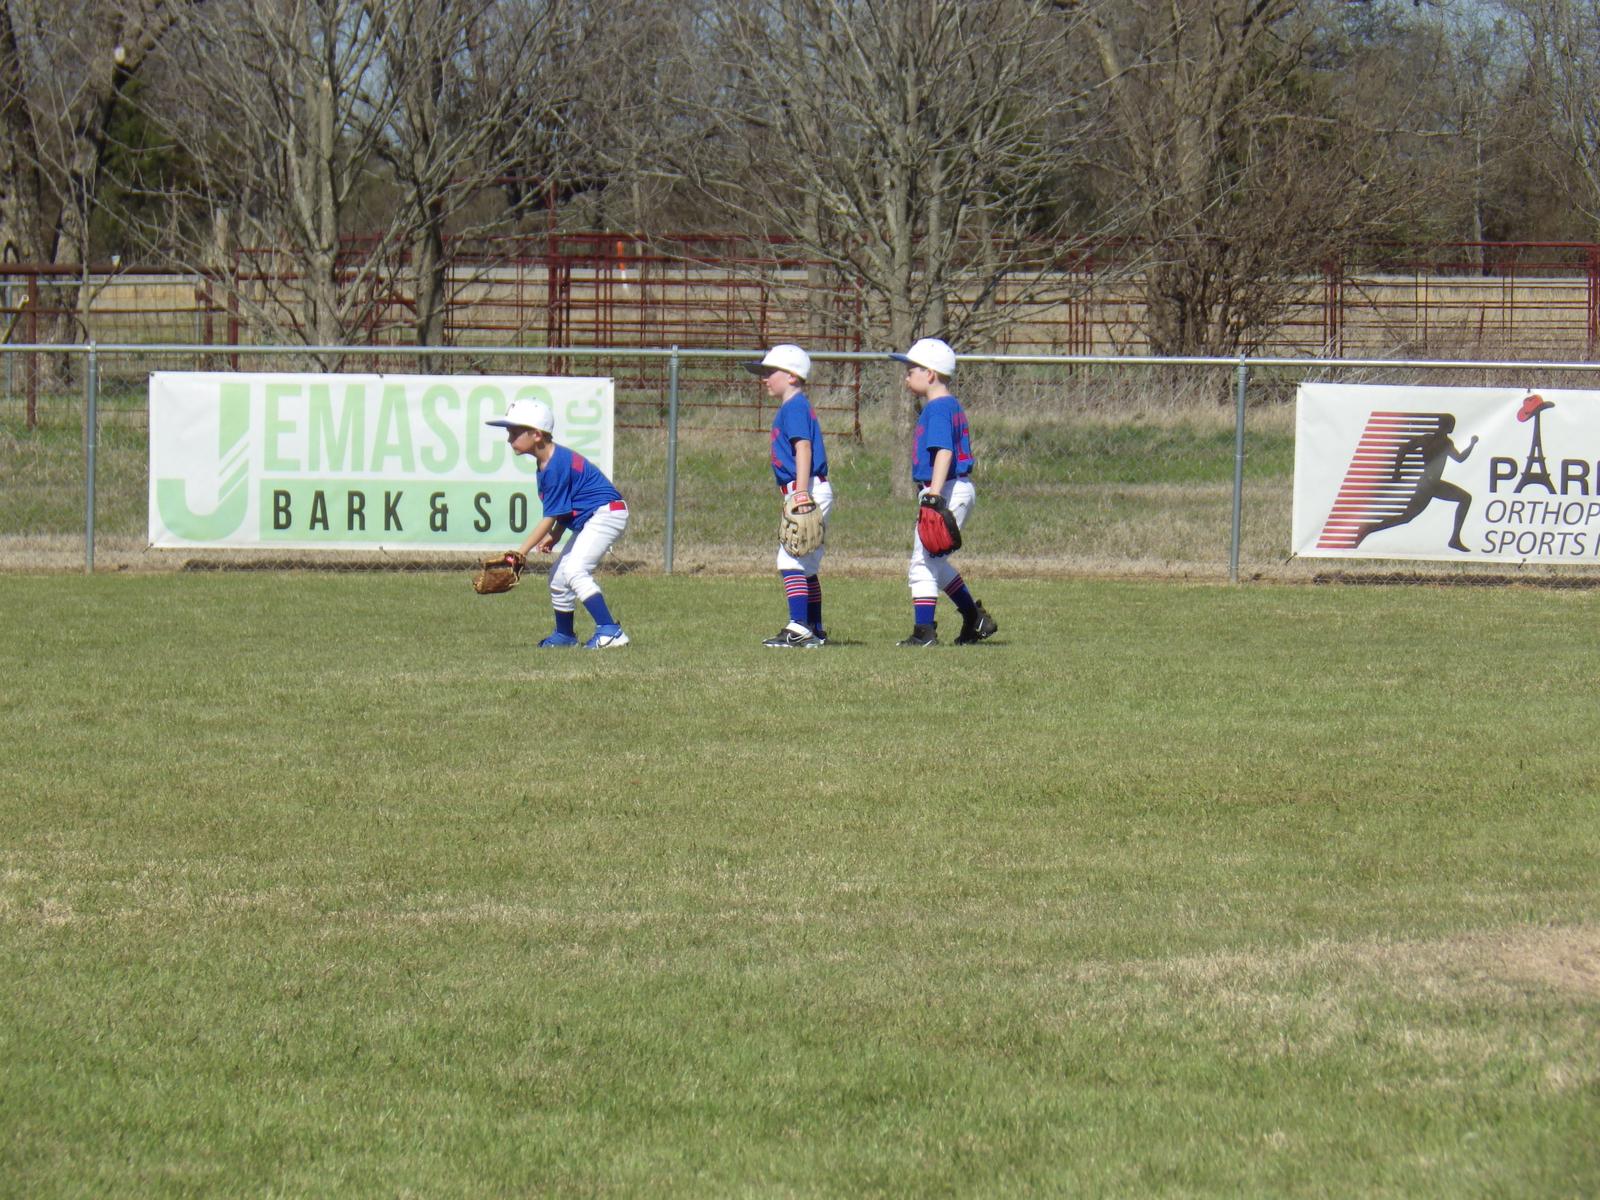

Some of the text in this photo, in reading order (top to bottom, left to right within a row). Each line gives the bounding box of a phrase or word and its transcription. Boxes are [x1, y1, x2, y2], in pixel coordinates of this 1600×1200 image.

[566, 388, 602, 466] NC.
[273, 490, 528, 533] BARK & SO
[1485, 499, 1600, 525] ORTHOP
[1481, 530, 1587, 556] SPORTS
